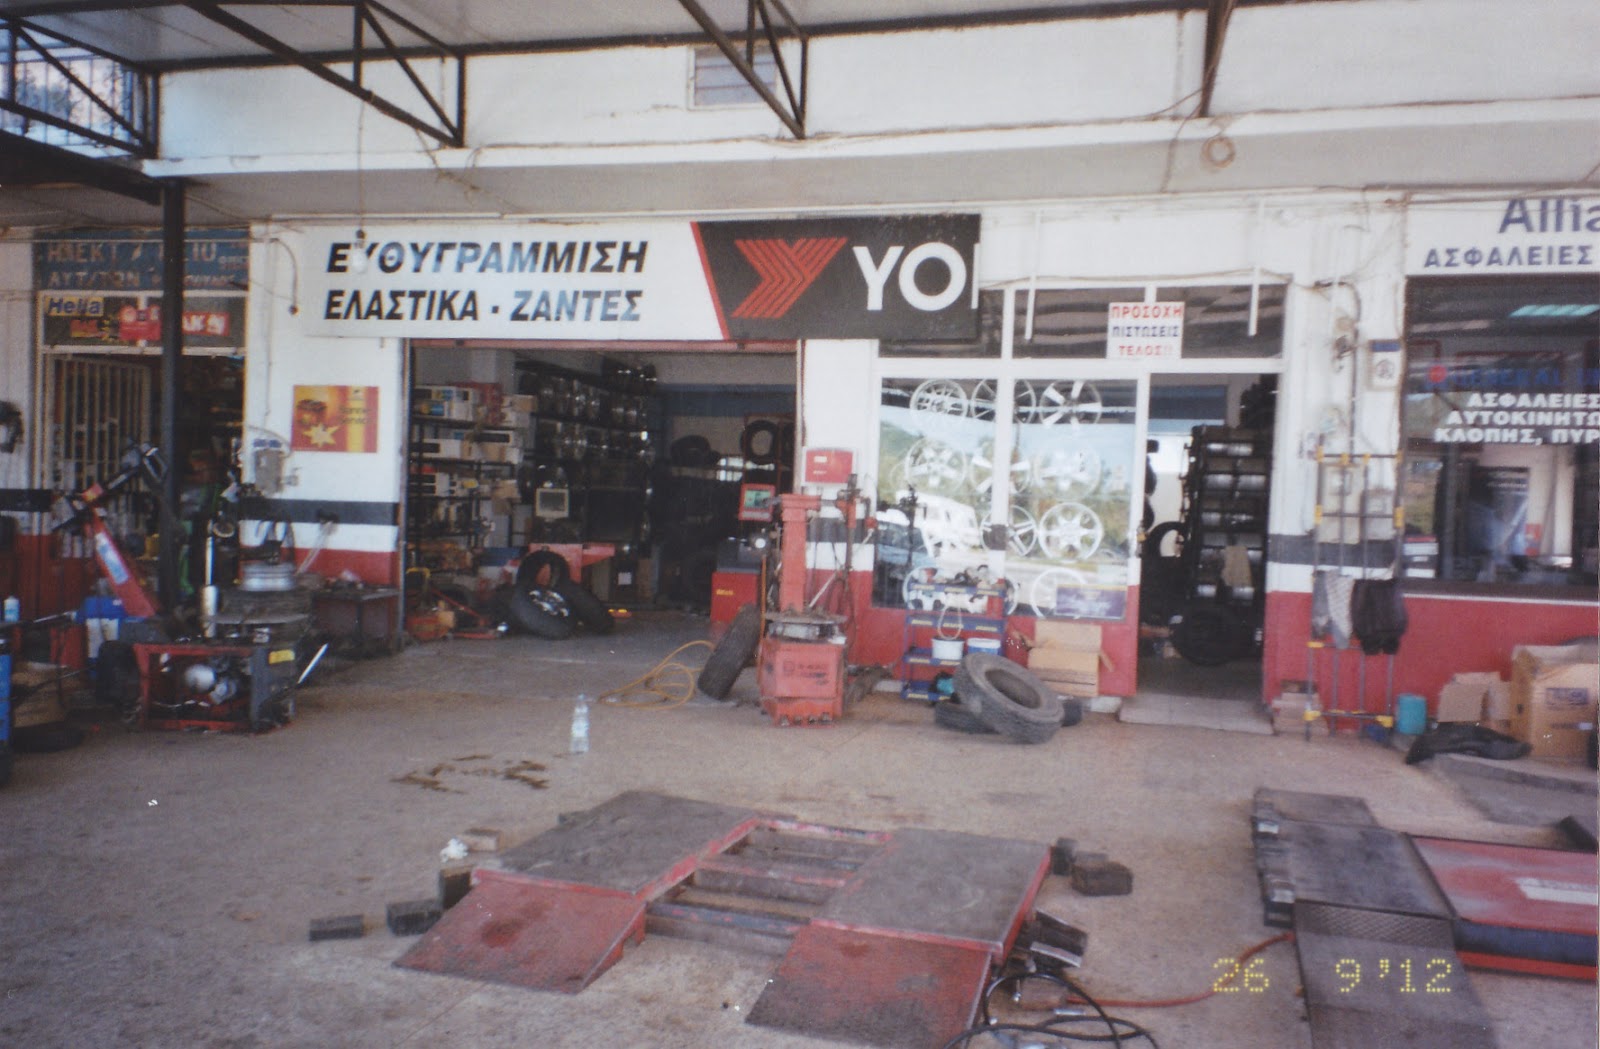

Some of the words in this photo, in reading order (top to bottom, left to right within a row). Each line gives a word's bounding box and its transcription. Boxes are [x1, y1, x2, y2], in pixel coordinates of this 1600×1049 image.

[1424, 245, 1593, 268] ΑΣΦΑΛΕΙΕΣ
[324, 290, 479, 320] ΕΛΑΣΤΙΚΑ
[510, 290, 643, 321] ΖΑΝΤΕΣ
[1112, 305, 1183, 319] ΠΡΟΣΟΧΗ
[1466, 392, 1599, 409] ΑΣΦΑΛΕΙΕΣ
[1433, 427, 1543, 446] ΚΛΟΠΗΣ,
[1551, 428, 1599, 444] ΠΥΡ
